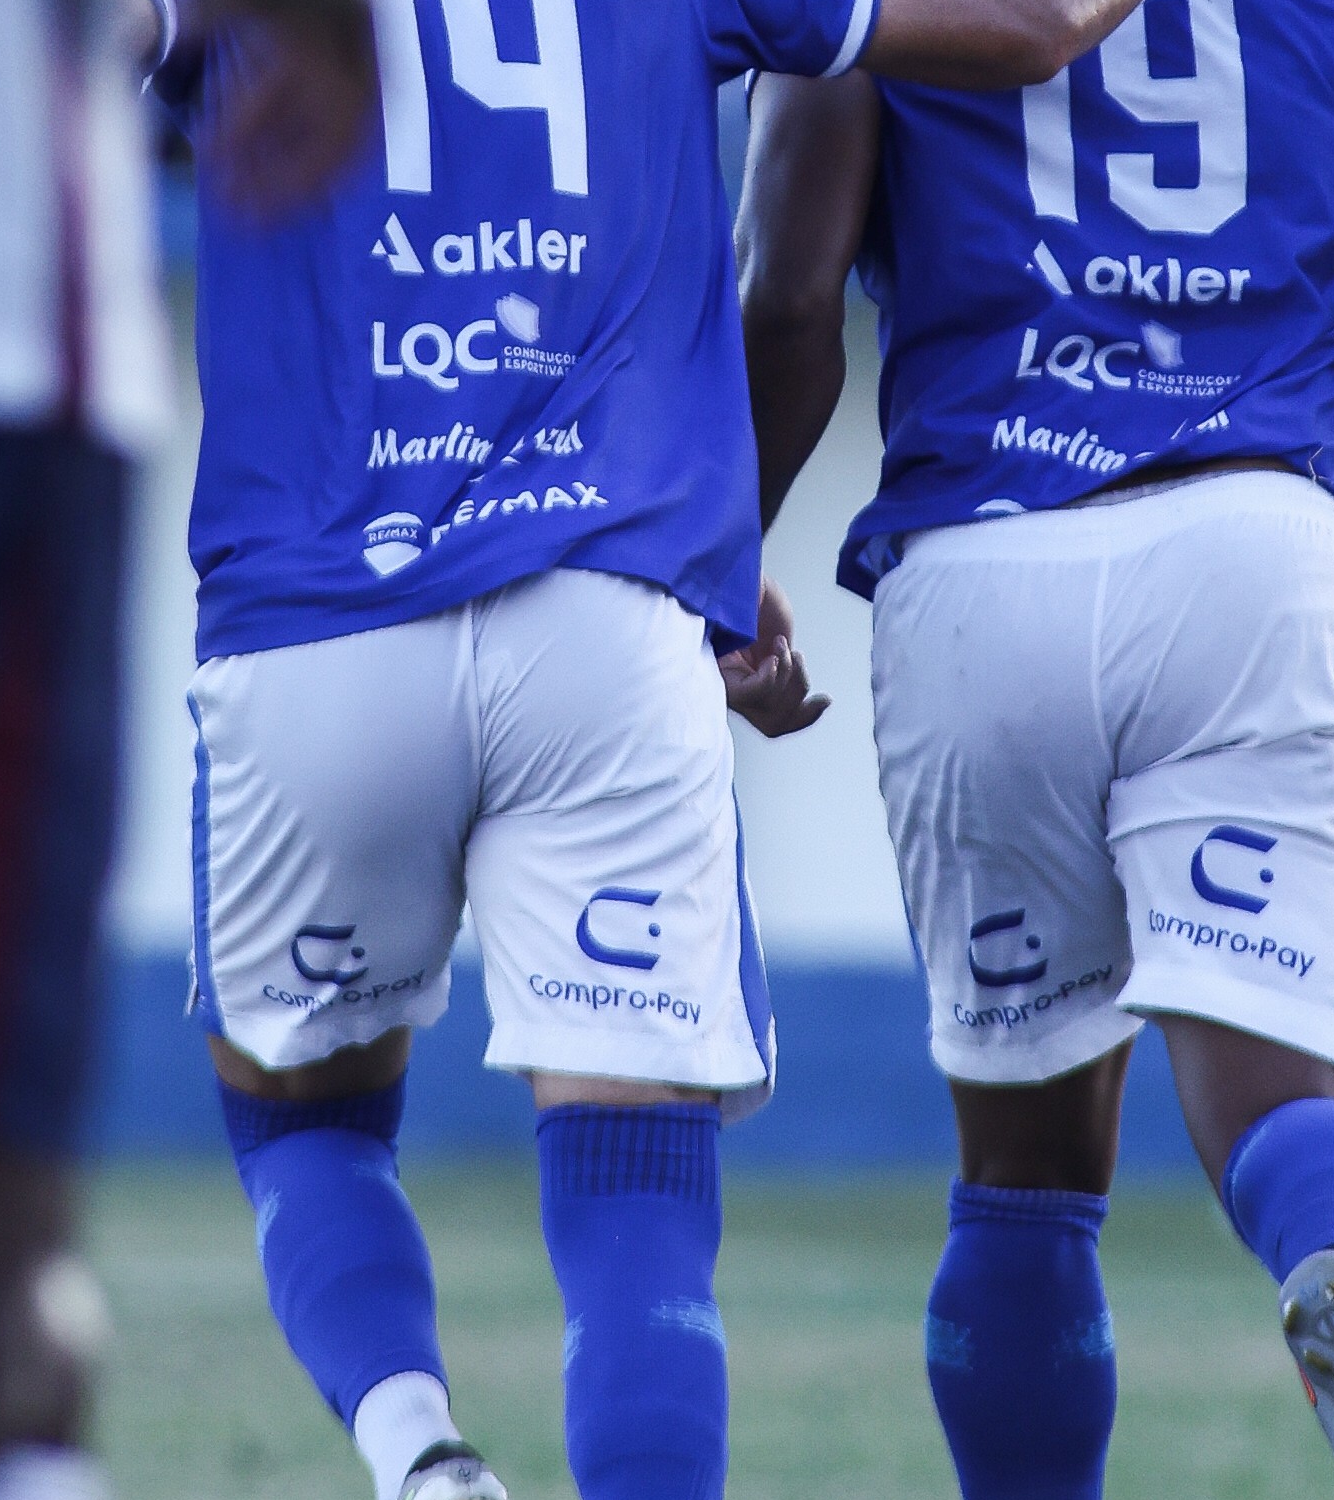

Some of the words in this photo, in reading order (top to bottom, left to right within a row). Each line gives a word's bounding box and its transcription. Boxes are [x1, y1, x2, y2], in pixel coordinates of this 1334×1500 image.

[432, 217, 588, 276] akler
[1084, 254, 1252, 303] akler
[372, 318, 499, 391] LQC
[1016, 326, 1141, 391] LQC
[367, 420, 494, 470] Marlim
[992, 415, 1128, 473] Marlim
[367, 527, 418, 543] RE/MAX
